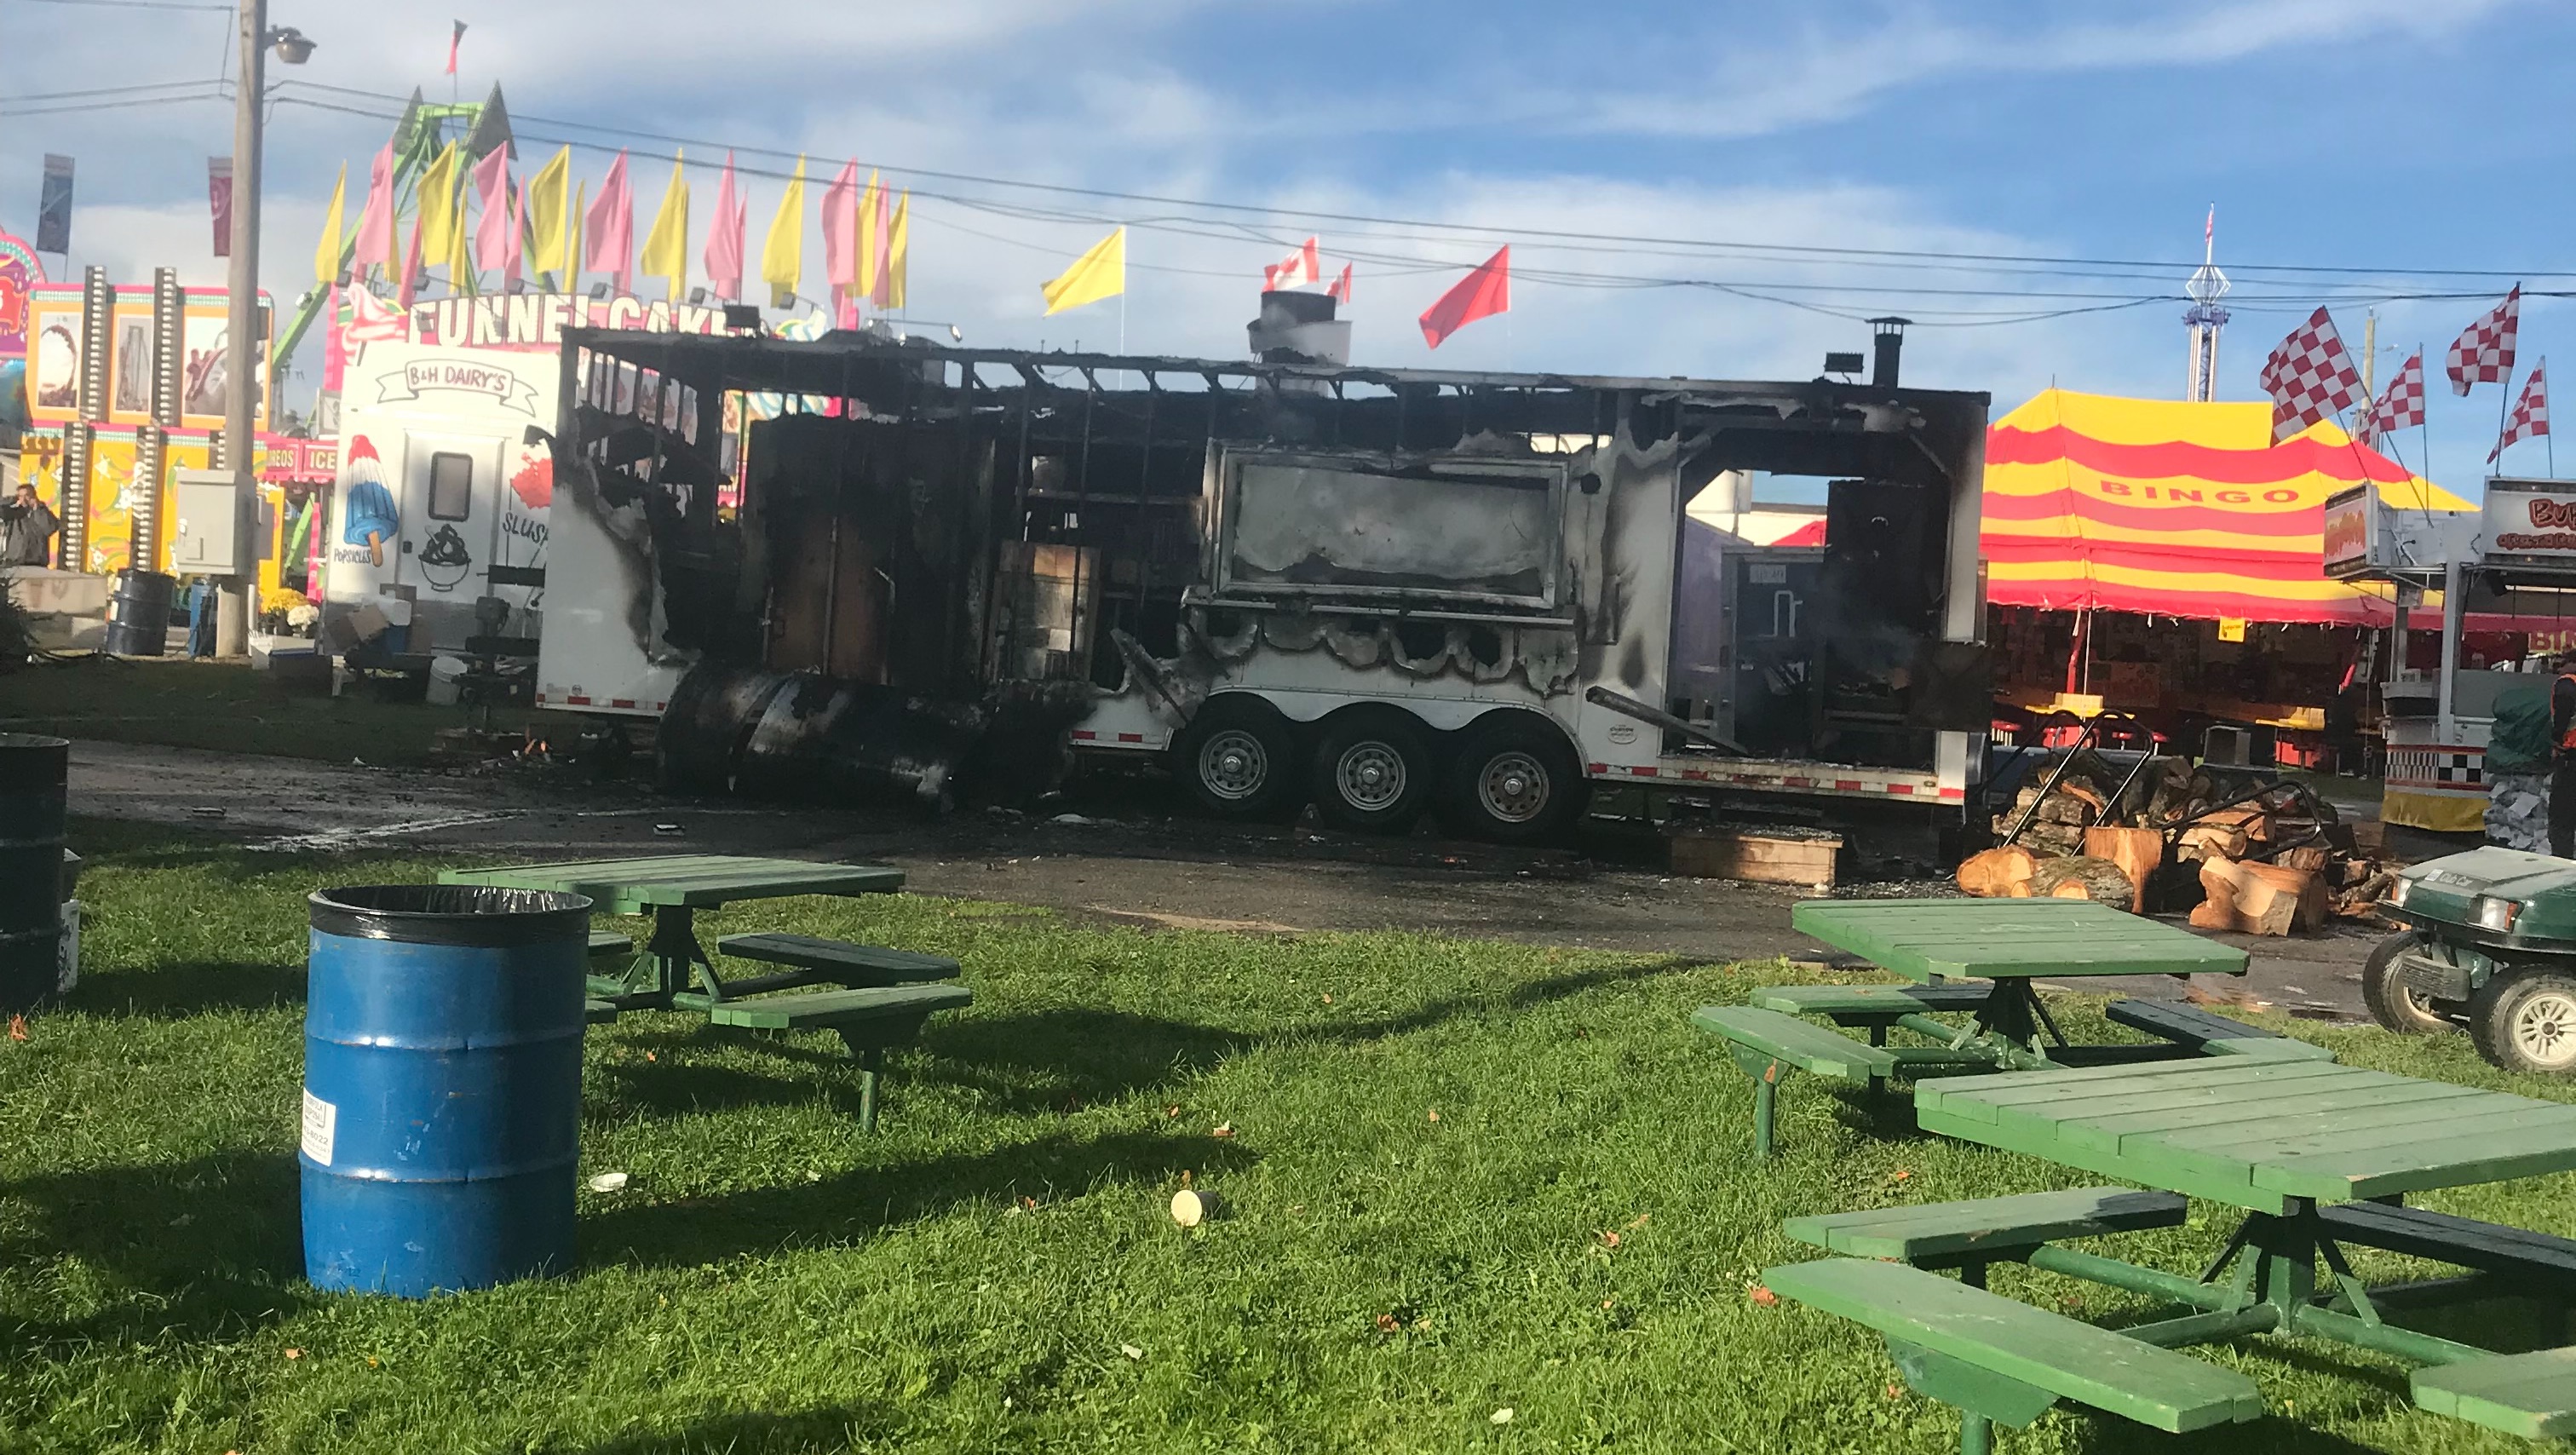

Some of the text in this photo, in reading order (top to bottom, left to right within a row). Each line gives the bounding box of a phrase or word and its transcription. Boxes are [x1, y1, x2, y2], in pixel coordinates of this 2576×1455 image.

[410, 365, 507, 392] B&H DAIRY'S
[309, 451, 336, 469] ICE
[2100, 480, 2299, 503] BINGO
